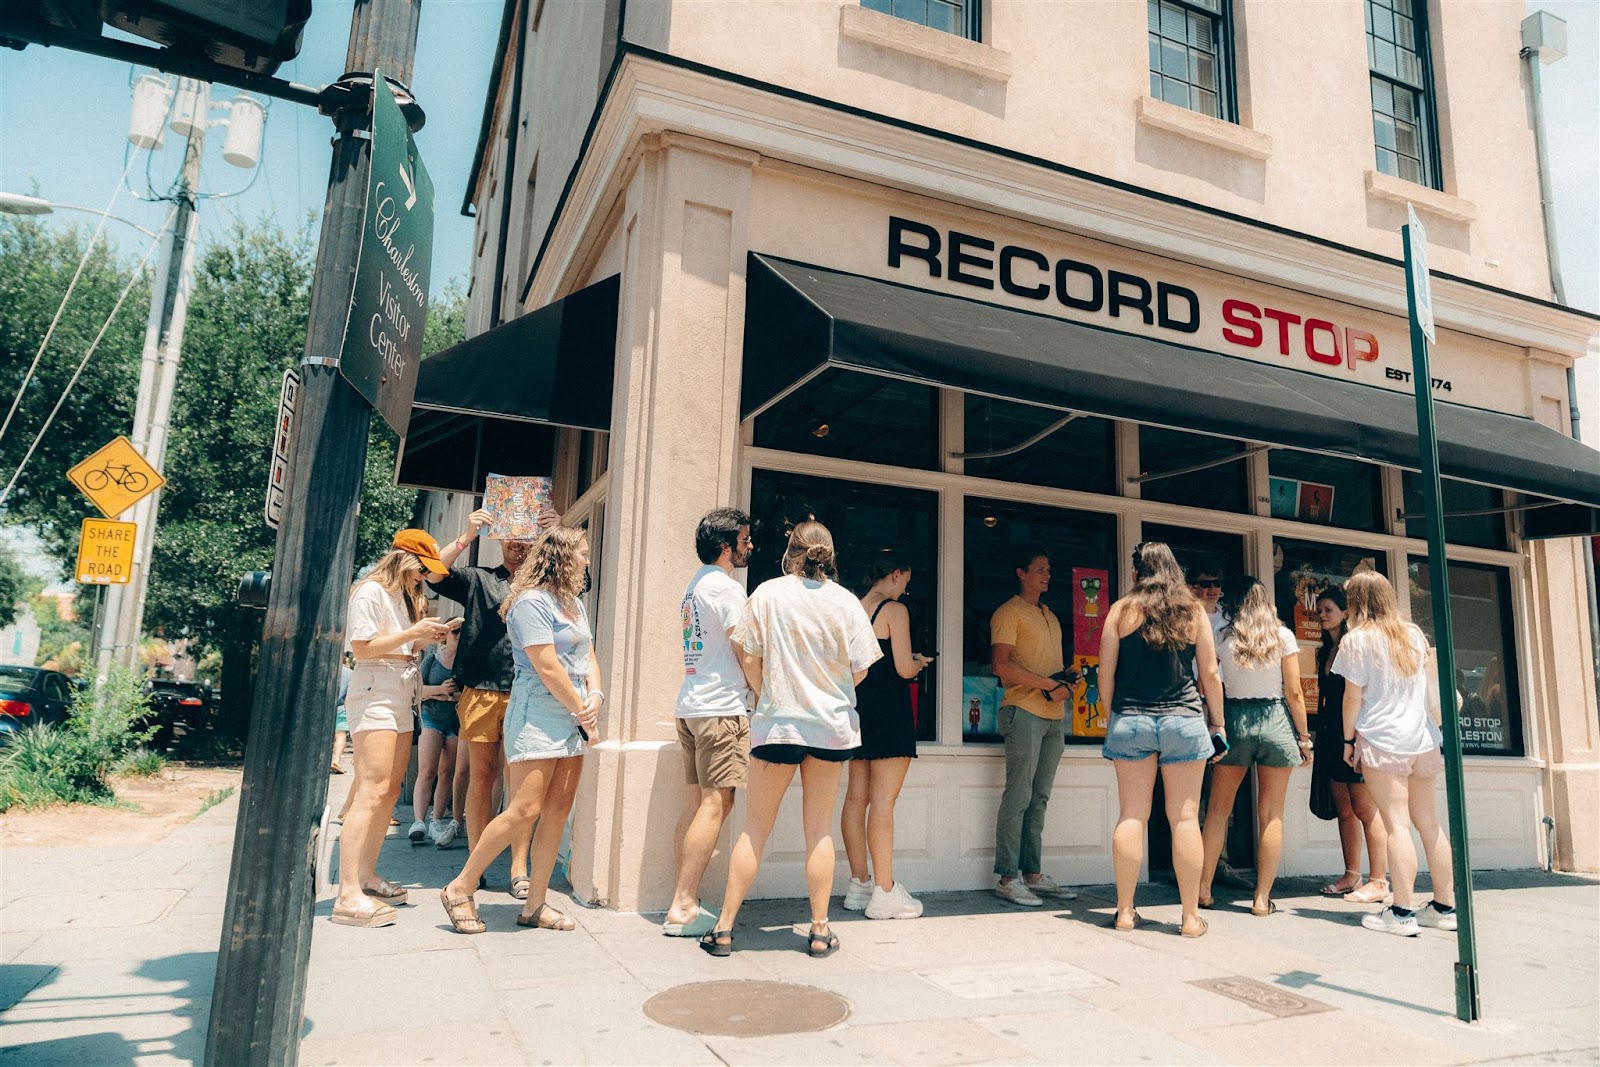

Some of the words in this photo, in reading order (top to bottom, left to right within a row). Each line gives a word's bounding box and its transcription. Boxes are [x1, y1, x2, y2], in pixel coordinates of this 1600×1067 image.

[375, 181, 425, 307] Charleston
[887, 215, 1201, 335] RECORD
[1221, 298, 1379, 371] STOP
[379, 271, 411, 342] Visitor
[370, 313, 406, 380] Center
[1385, 367, 1411, 382] EST
[1431, 377, 1452, 391] 74
[88, 527, 131, 542] SHARE
[96, 545, 119, 558] THE
[88, 562, 122, 576] ROAD
[1474, 718, 1501, 728] STOP
